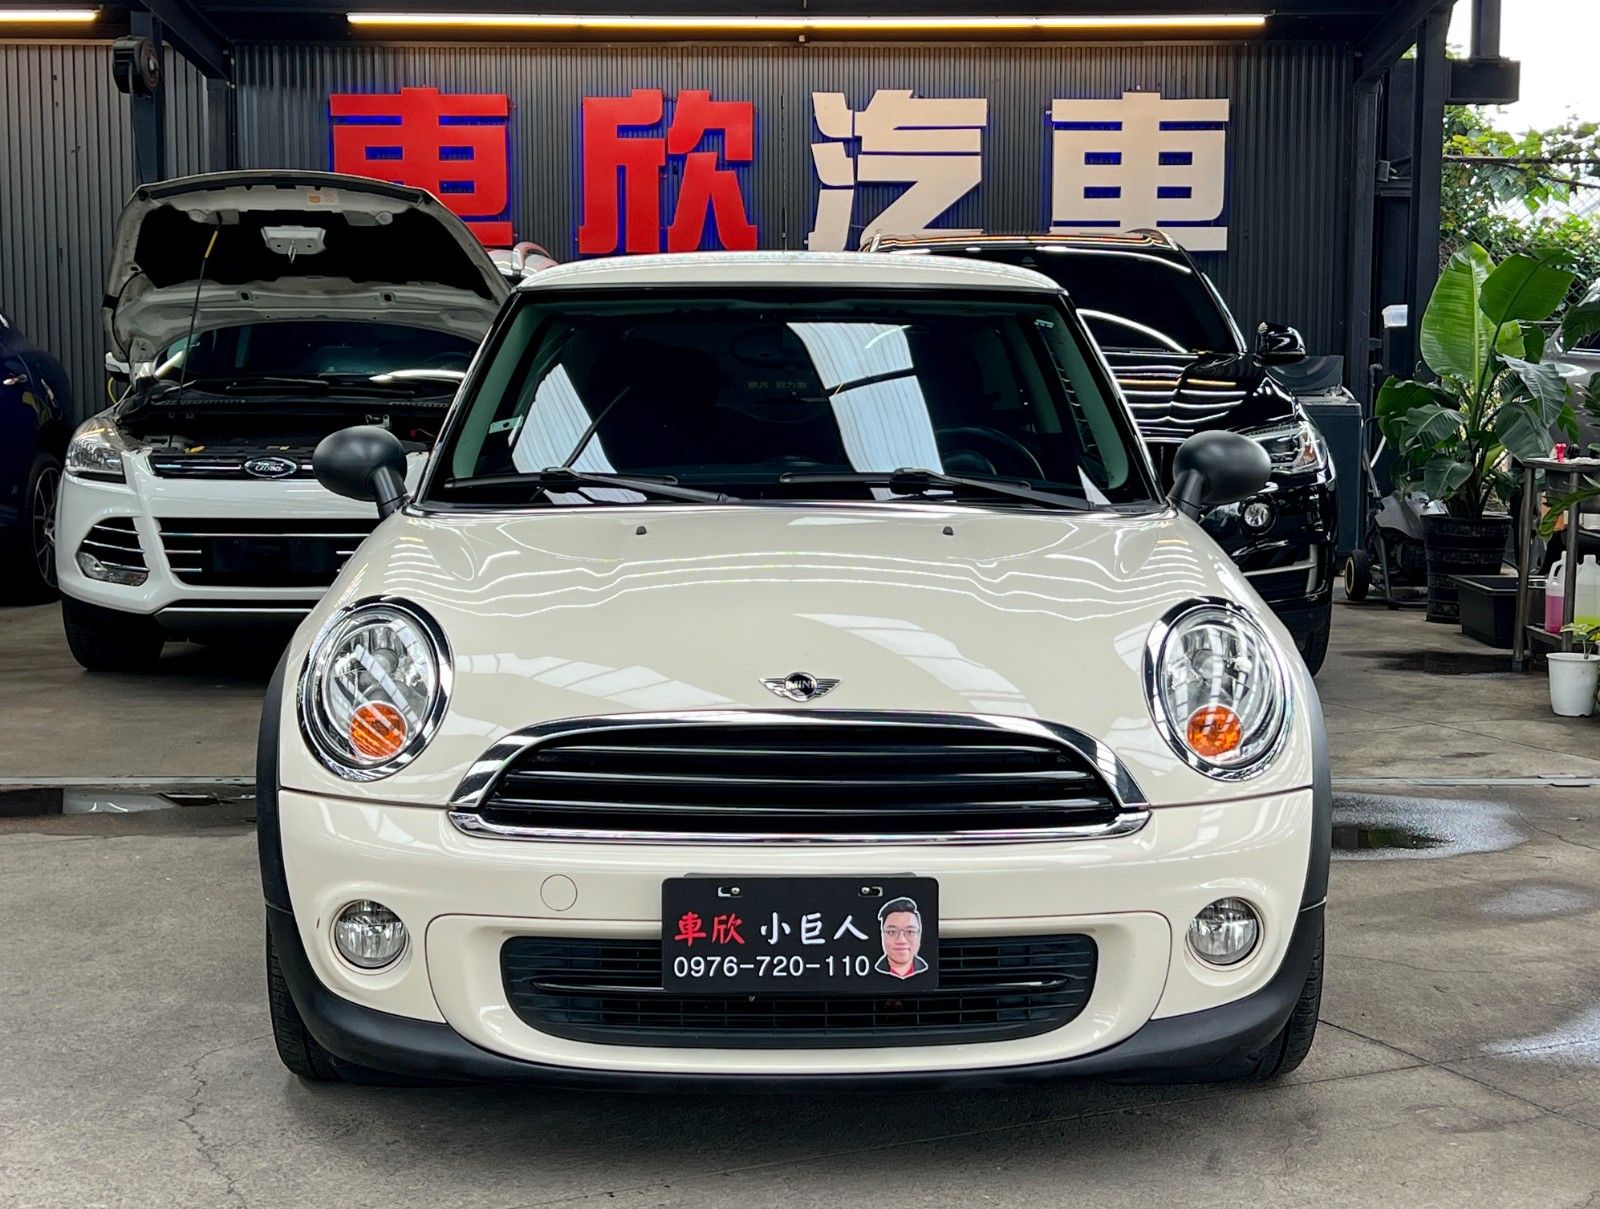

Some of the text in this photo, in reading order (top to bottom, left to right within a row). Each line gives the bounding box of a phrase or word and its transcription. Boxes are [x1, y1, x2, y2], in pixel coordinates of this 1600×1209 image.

[674, 911, 869, 947] 車欣 小巨人
[673, 955, 870, 978] 0976-720-110
